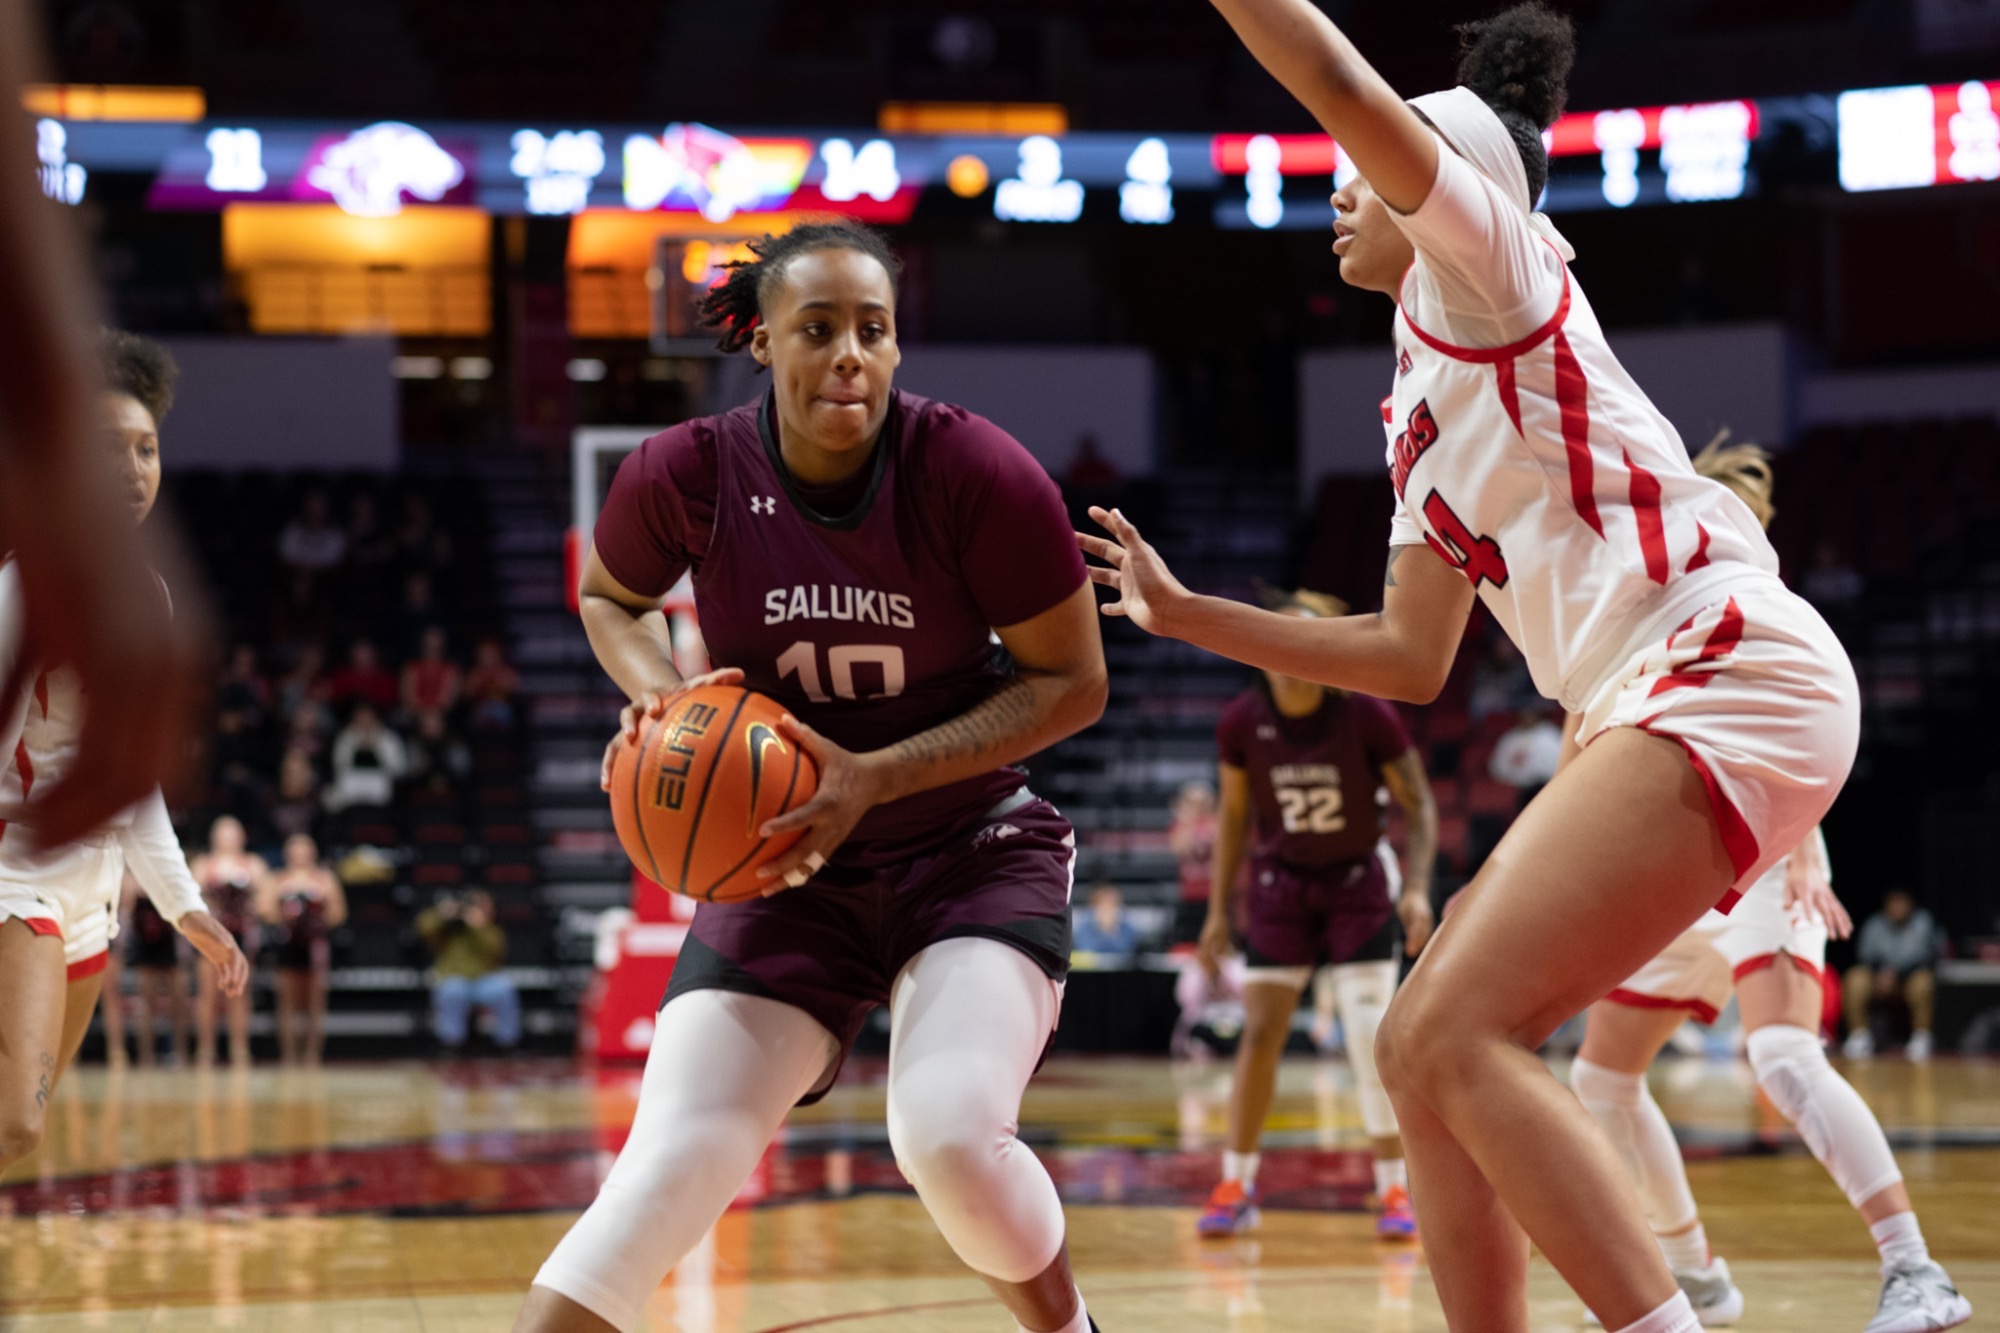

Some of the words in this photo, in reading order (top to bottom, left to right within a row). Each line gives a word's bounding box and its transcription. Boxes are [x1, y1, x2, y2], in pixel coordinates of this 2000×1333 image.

[764, 584, 915, 629] SALUKIS
[776, 641, 905, 703] 10
[1275, 787, 1346, 834] 22
